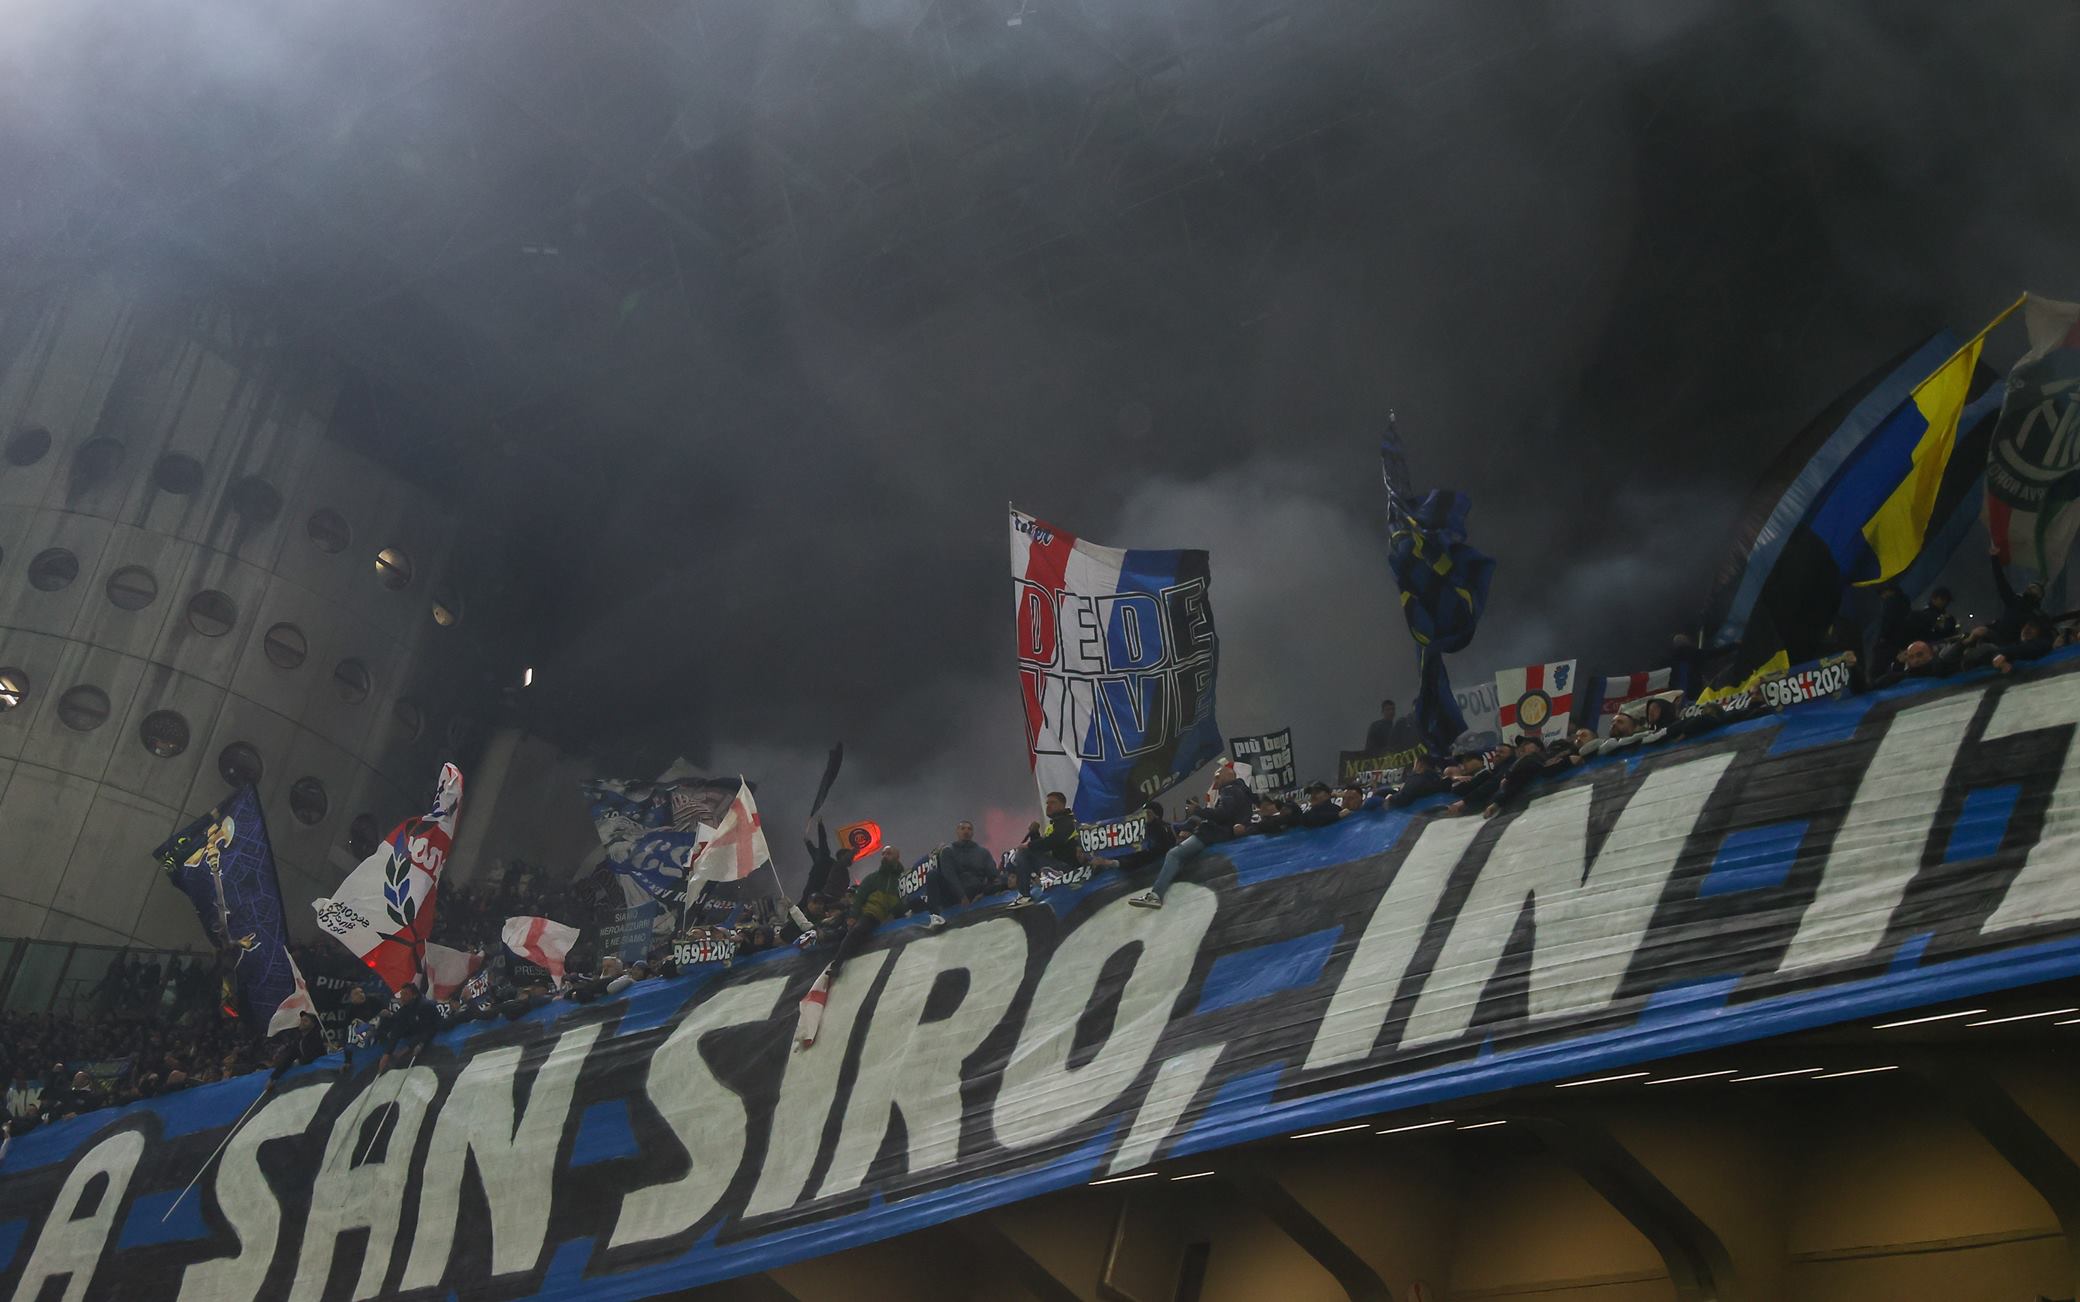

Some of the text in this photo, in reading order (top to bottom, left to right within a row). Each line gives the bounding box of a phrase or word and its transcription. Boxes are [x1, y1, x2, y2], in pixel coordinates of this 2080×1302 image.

[1013, 577, 1215, 675] DEDE
[1760, 662, 1850, 707] 1969 2024
[1080, 818, 1146, 852] 1969 2024
[673, 943, 700, 965] 969
[11, 1130, 145, 1302] A
[176, 1020, 603, 1302] SAN
[606, 883, 1227, 1250] SIRO,
[1303, 752, 1738, 1072] IN
